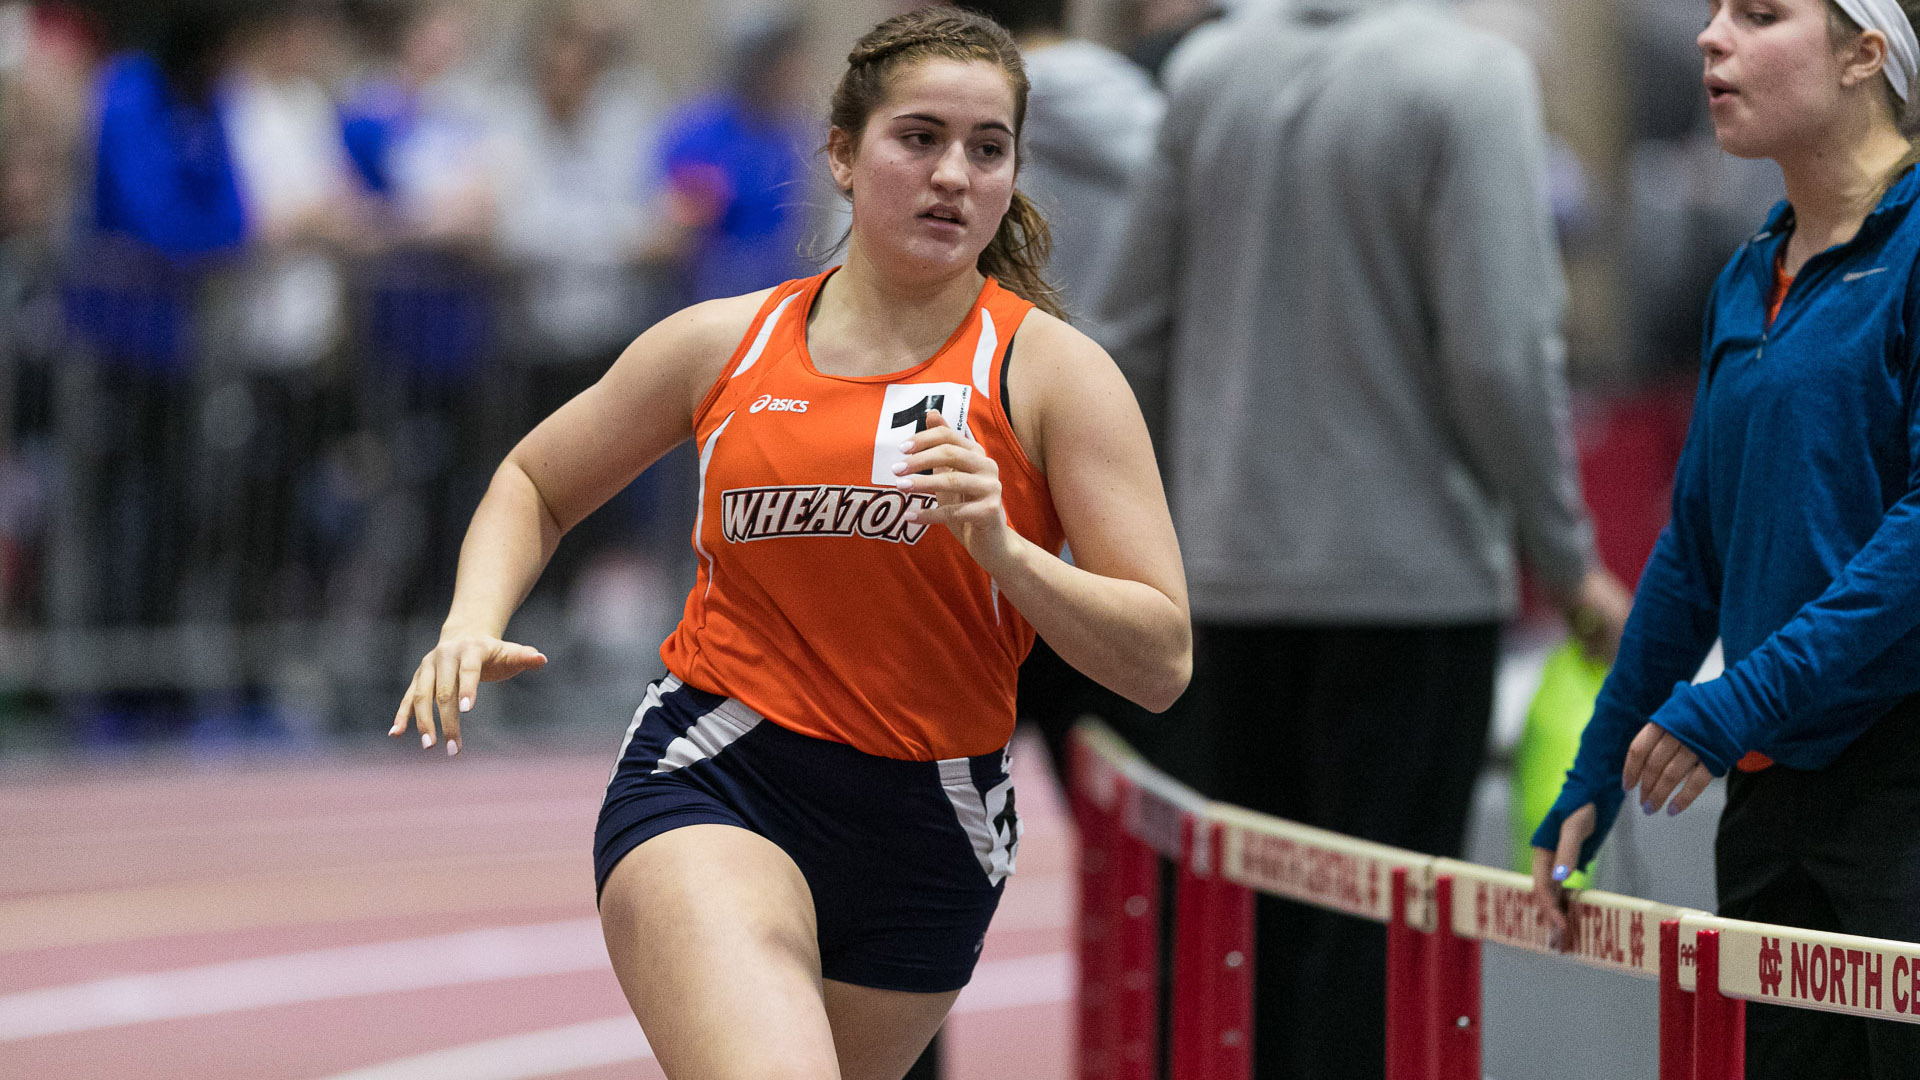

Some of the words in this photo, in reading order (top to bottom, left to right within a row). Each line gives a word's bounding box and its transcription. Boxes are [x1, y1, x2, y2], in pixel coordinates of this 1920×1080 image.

[768, 398, 810, 413] asics
[722, 485, 939, 545] WHEATON
[1791, 942, 1882, 1010] NORTH
